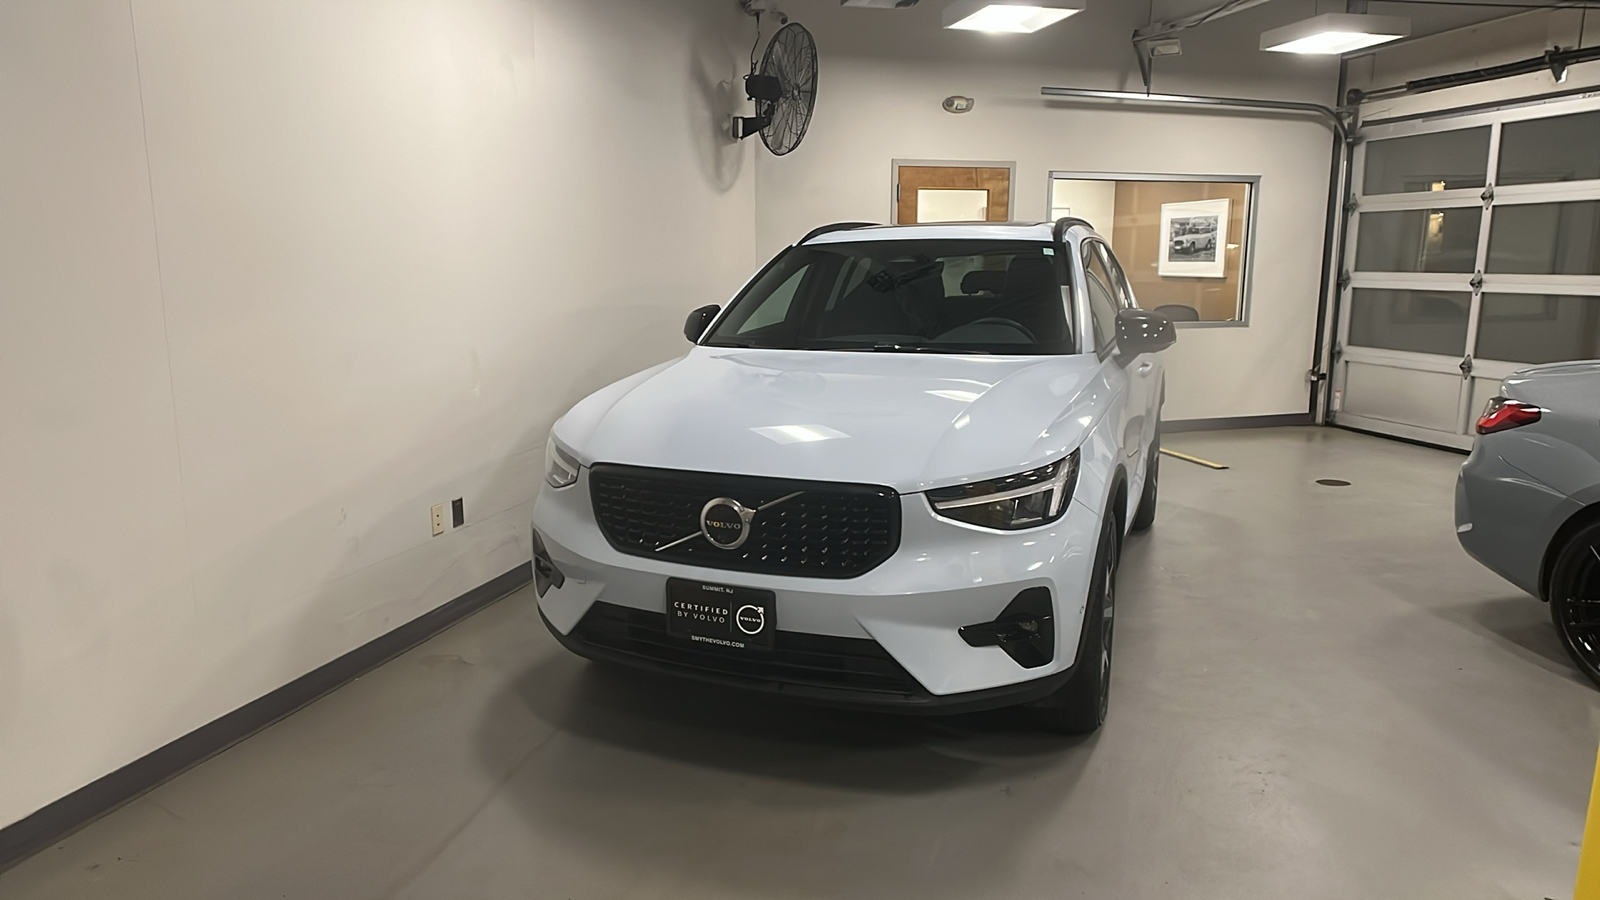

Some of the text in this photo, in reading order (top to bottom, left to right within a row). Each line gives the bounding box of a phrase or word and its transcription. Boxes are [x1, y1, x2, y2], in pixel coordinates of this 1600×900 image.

[706, 520, 741, 530] VOLVO
[674, 601, 728, 615] CERTIFIED
[677, 610, 725, 623] BY VOLVO
[691, 635, 745, 648] SMYTHEVOLVO.COM
